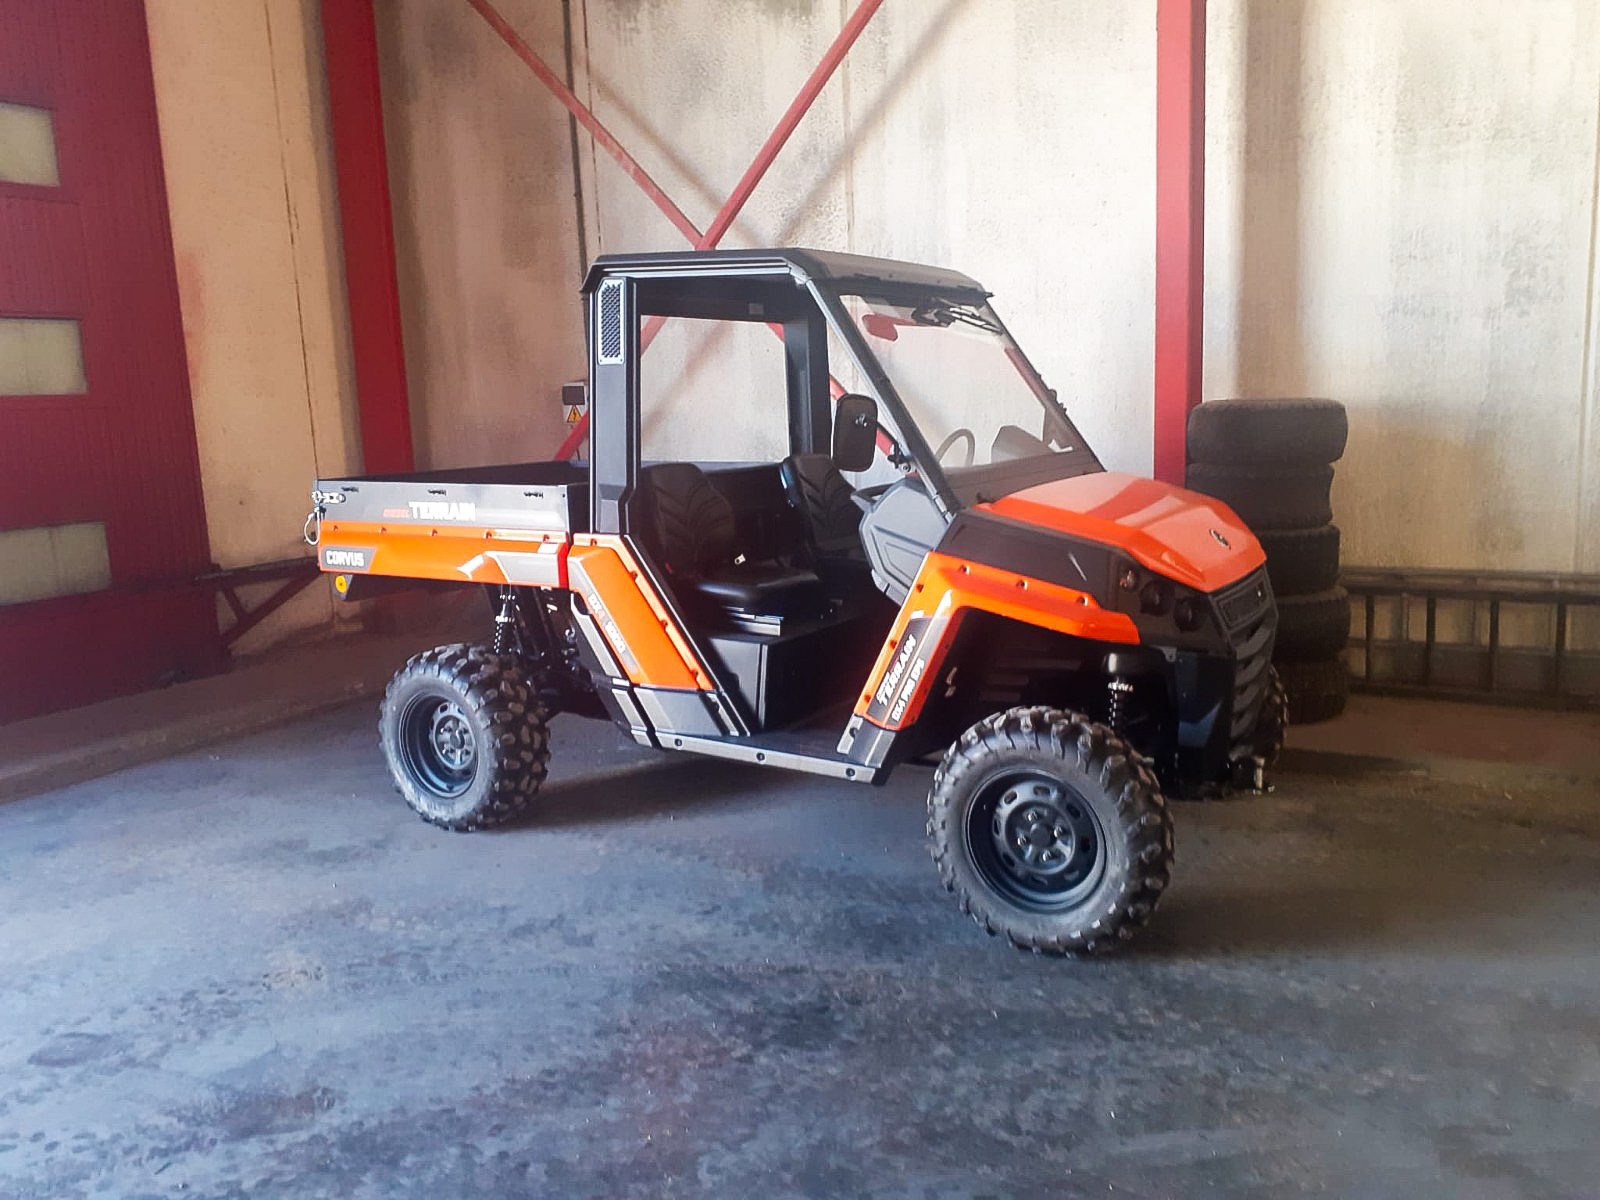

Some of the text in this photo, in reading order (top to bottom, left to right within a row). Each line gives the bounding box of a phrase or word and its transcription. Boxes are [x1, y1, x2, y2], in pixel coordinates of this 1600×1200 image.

[409, 502, 476, 521] TERRAIN
[326, 551, 364, 568] CORVUS
[878, 634, 916, 706] TERRAIN
